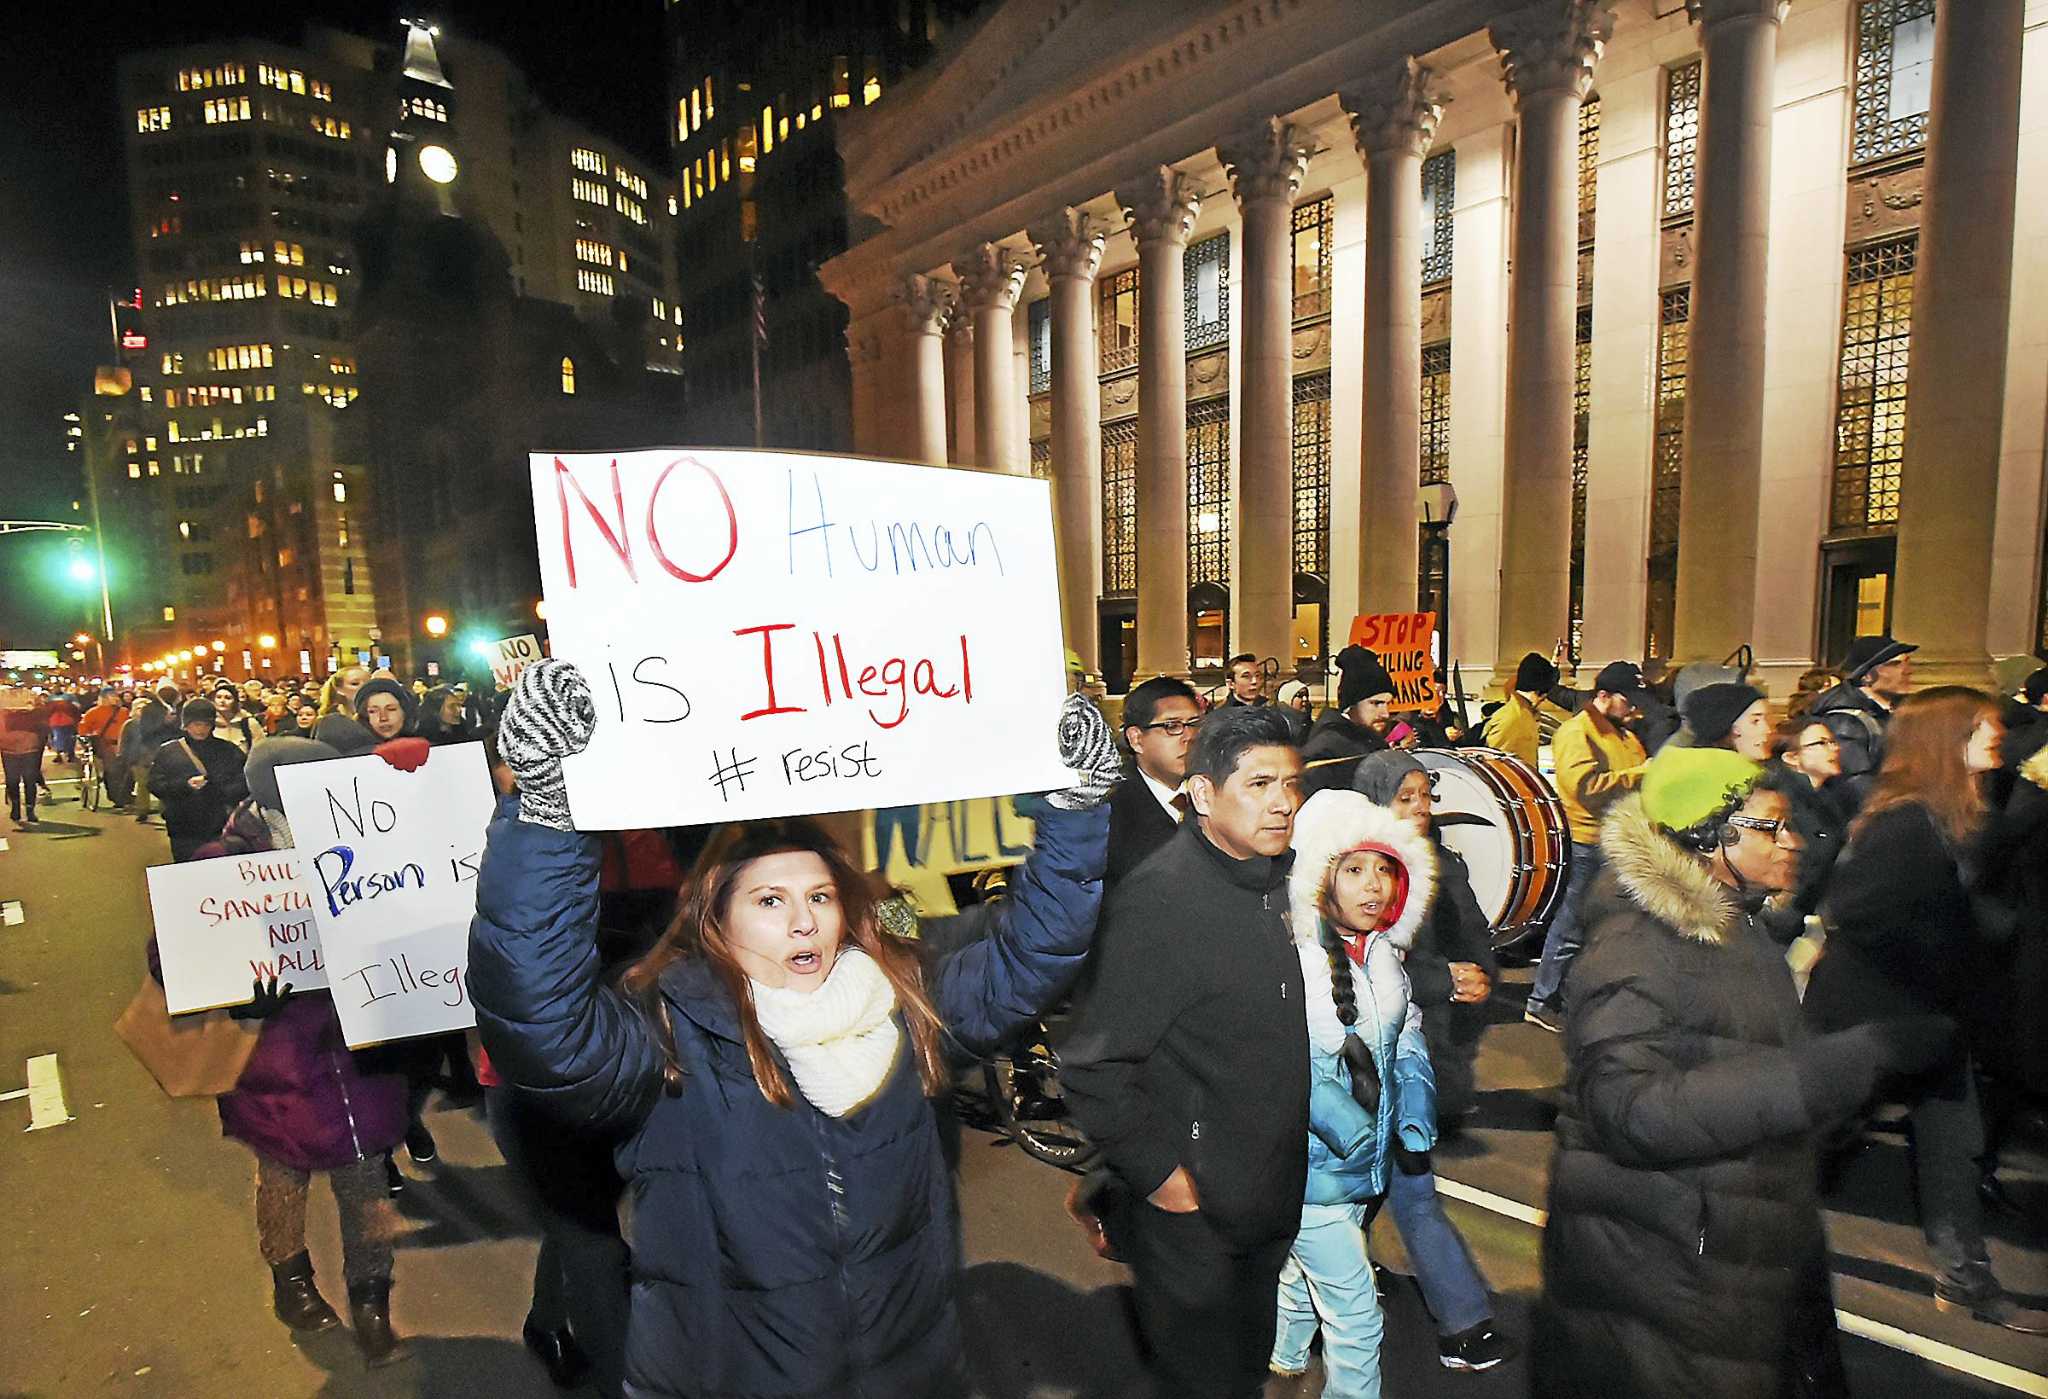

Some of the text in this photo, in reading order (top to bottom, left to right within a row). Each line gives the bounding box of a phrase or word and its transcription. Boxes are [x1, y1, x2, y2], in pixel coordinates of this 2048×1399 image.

[555, 456, 1004, 589] NO Human
[498, 639, 531, 660] NO
[1360, 613, 1427, 647] STOP
[733, 624, 972, 728] Illegal
[1377, 650, 1424, 672] ILING
[782, 741, 882, 785] resist
[325, 777, 396, 838] No
[238, 859, 301, 886] BUIL
[314, 846, 425, 917] Person
[200, 890, 311, 927] SANCTU
[269, 919, 312, 947] NOT
[342, 954, 463, 1007] Illeg
